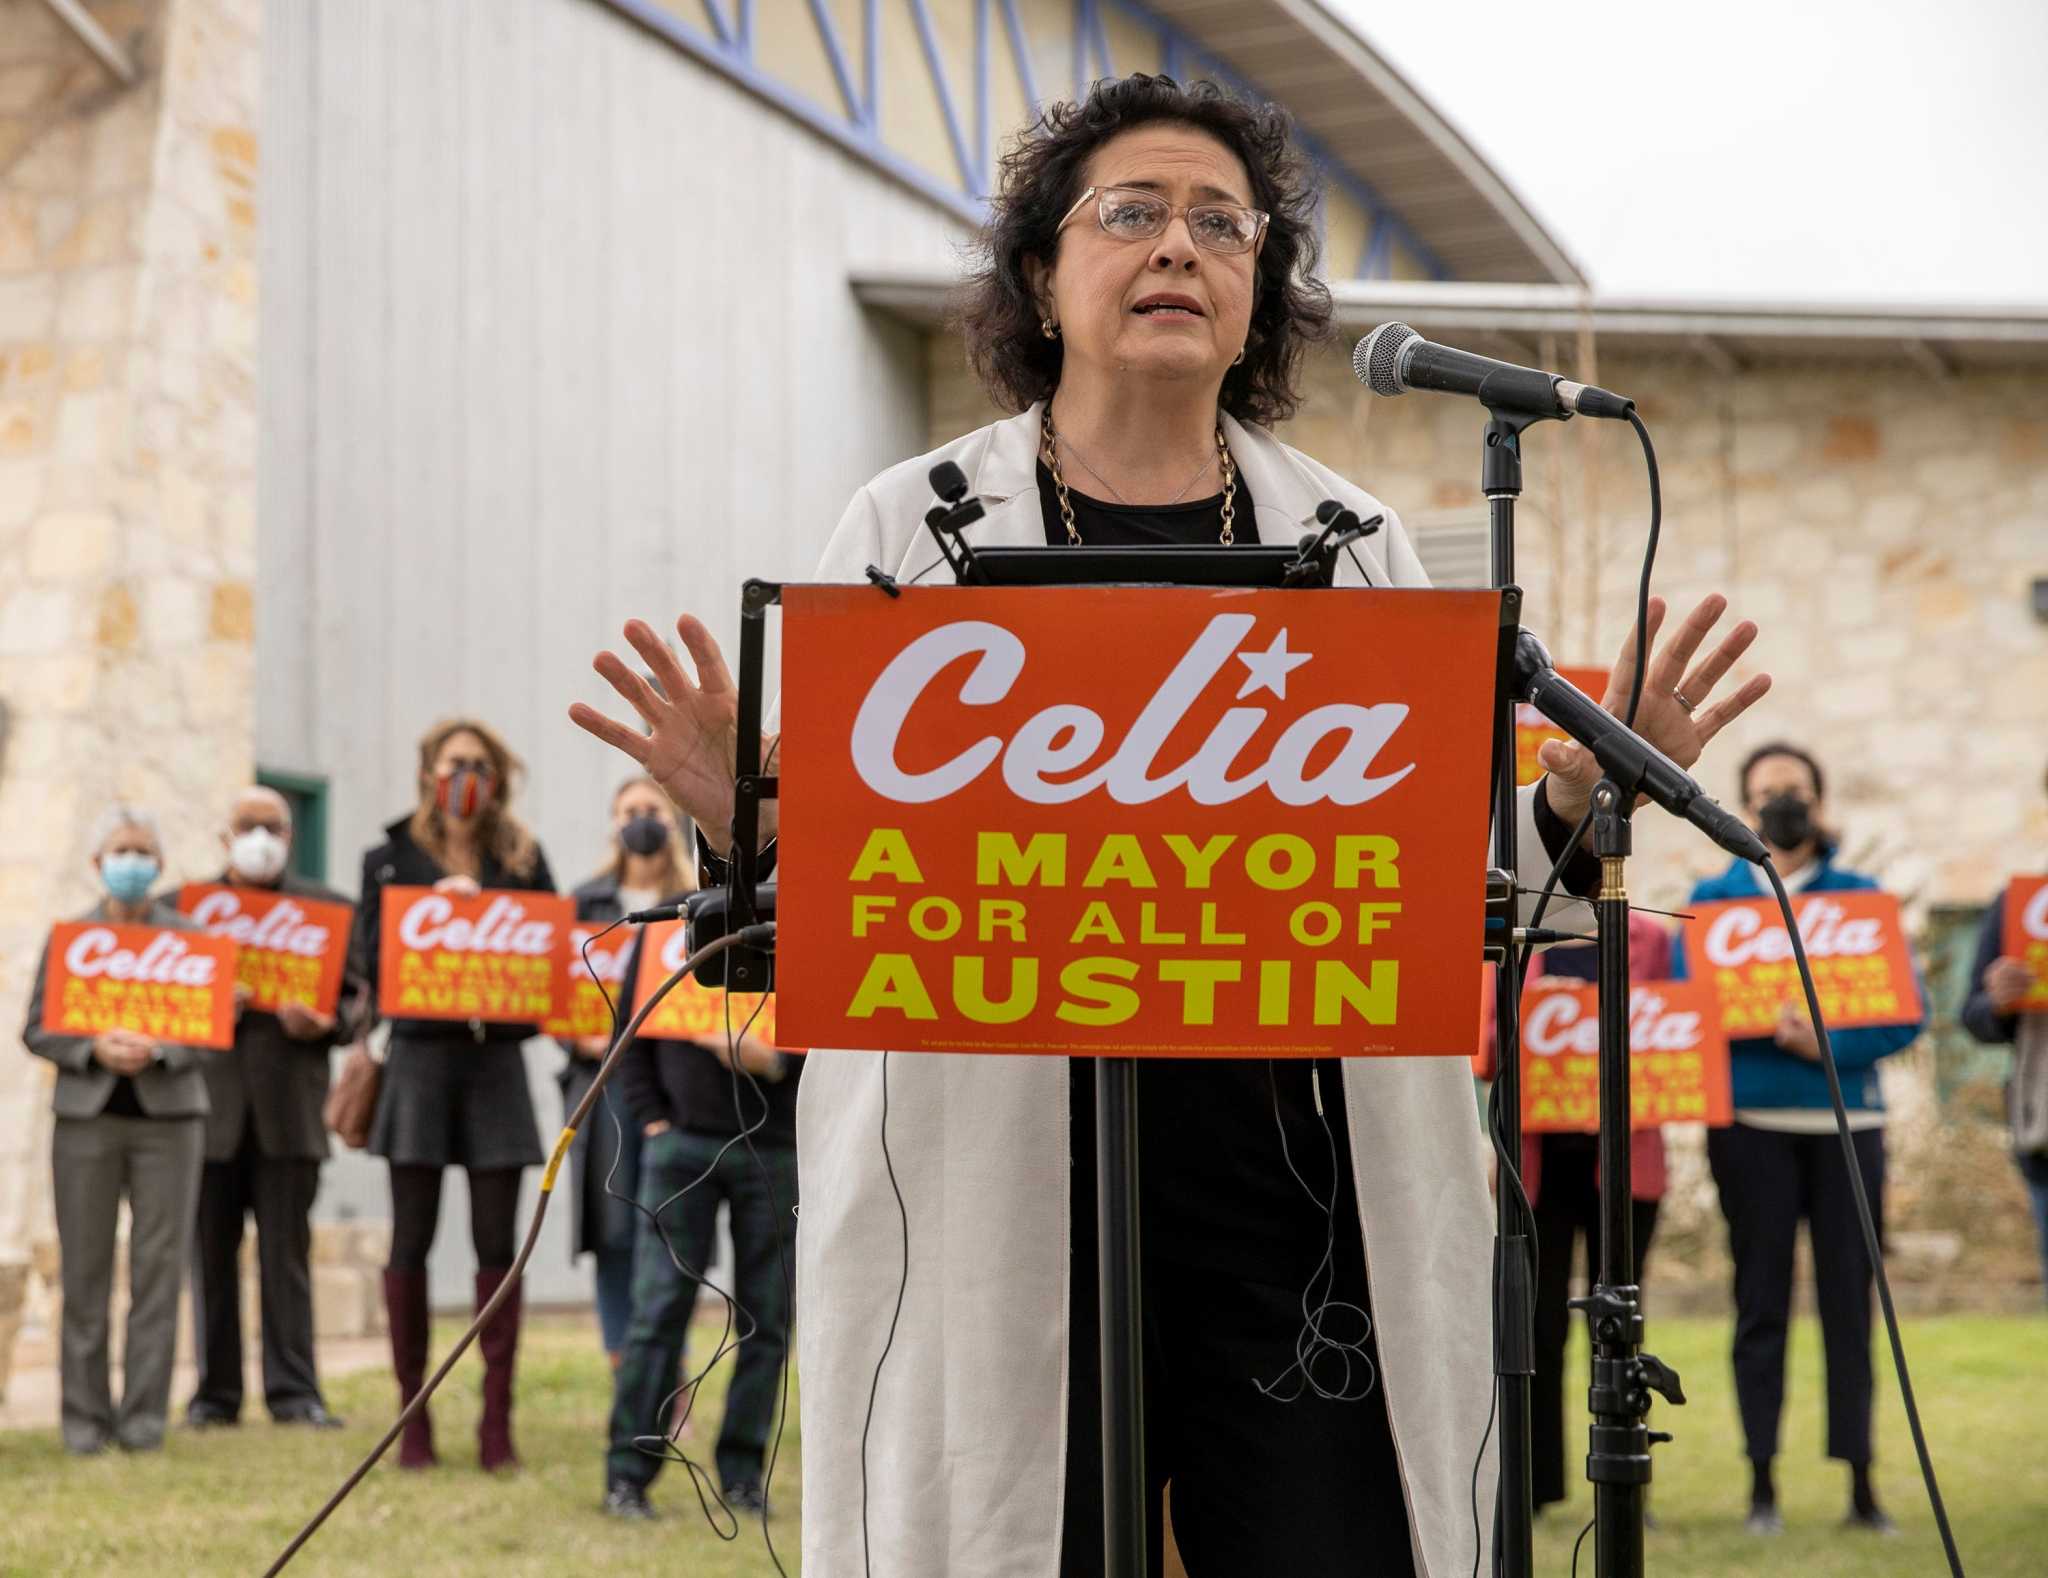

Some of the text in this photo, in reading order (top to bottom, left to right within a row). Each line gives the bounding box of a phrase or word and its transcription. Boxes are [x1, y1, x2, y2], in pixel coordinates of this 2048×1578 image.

[850, 612, 1417, 807] Celia
[848, 827, 1402, 891] A MAYOR
[192, 890, 329, 957] Celia
[400, 895, 554, 955] Celia
[850, 894, 1403, 947] FOR ALL OF
[1704, 897, 1885, 967] Celia
[65, 927, 216, 986] Celia
[845, 952, 1400, 1026] AUSTIN
[1533, 1093, 1706, 1121] AUTIN
